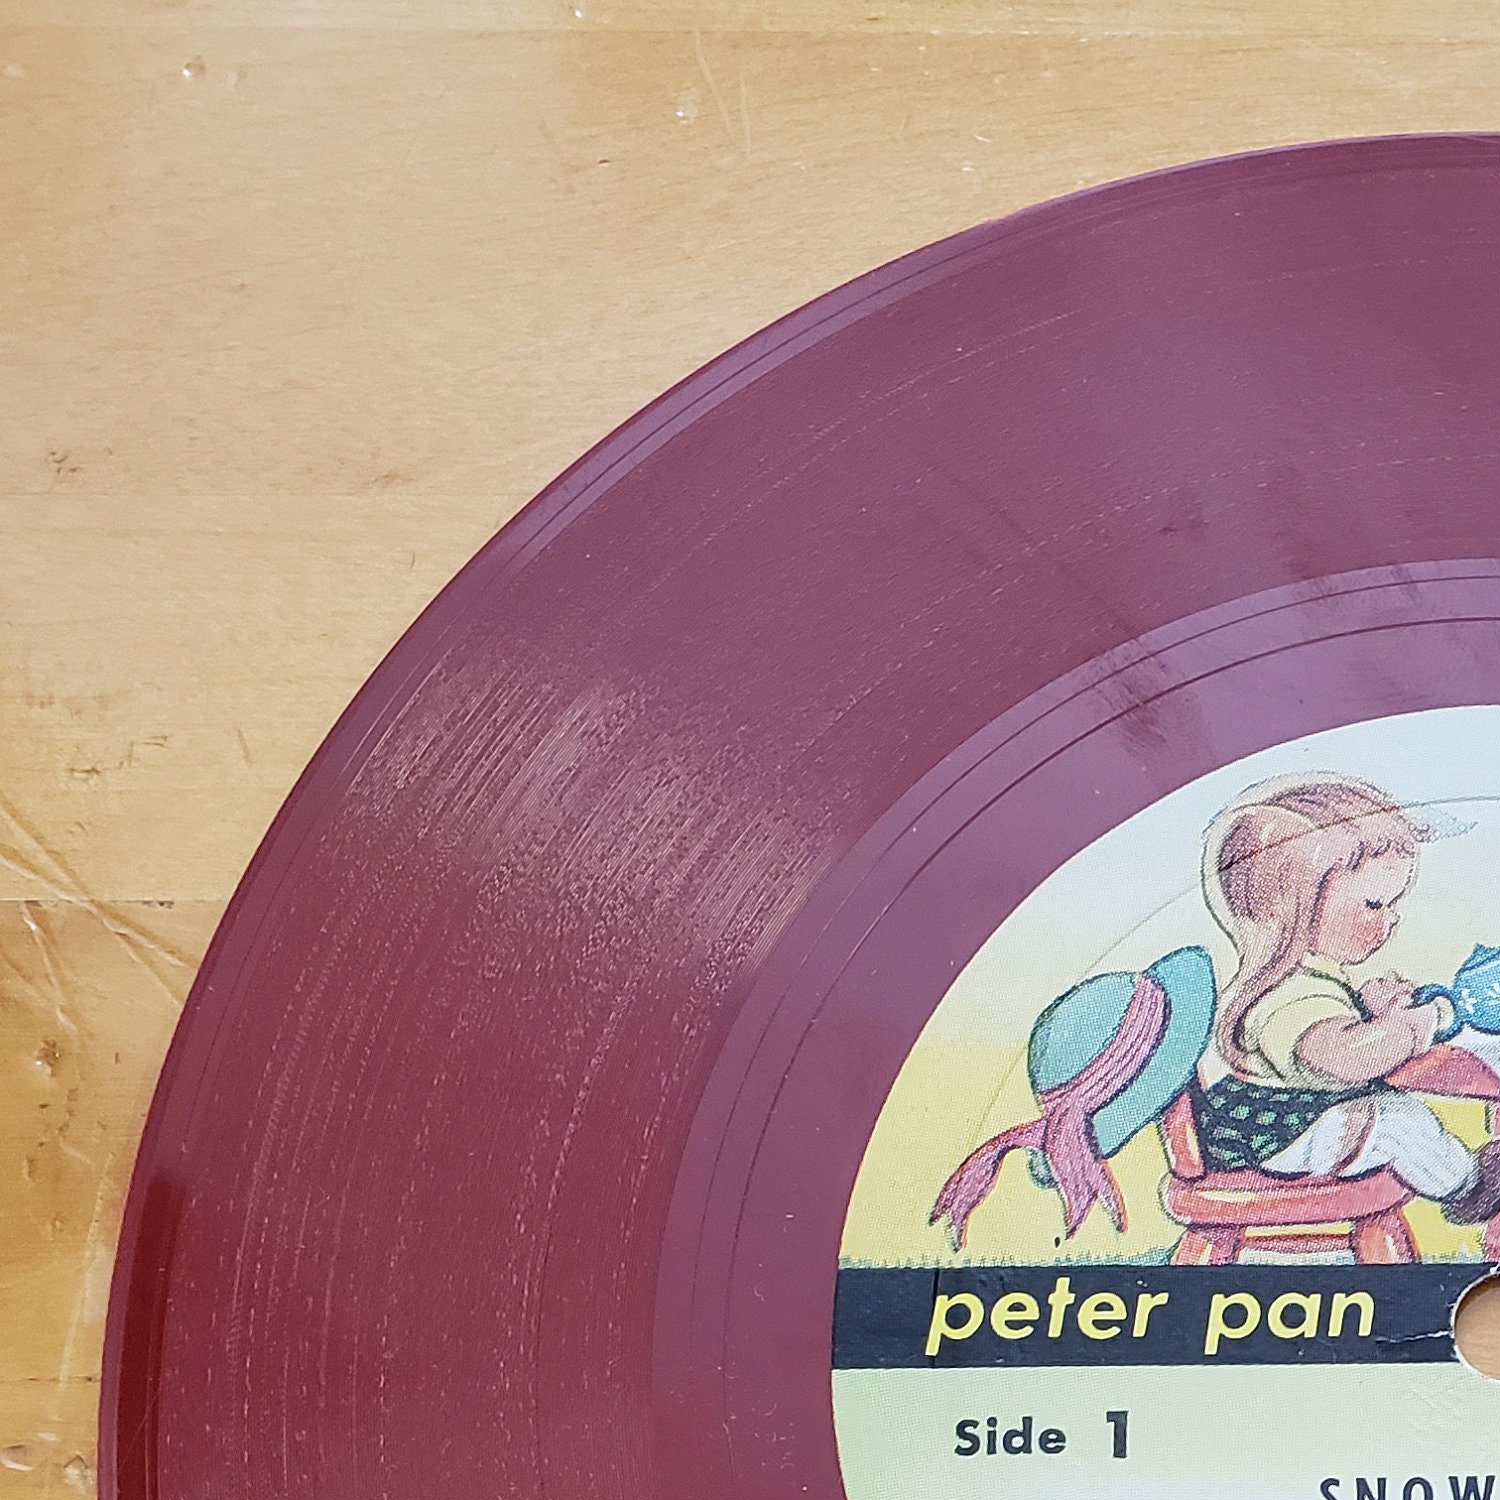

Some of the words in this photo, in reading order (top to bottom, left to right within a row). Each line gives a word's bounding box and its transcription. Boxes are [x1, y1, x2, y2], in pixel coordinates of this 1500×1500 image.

[925, 1276, 1168, 1356] peter
[1203, 1290, 1375, 1355] pan
[954, 1416, 1067, 1456] Side
[1105, 1410, 1129, 1459] 1
